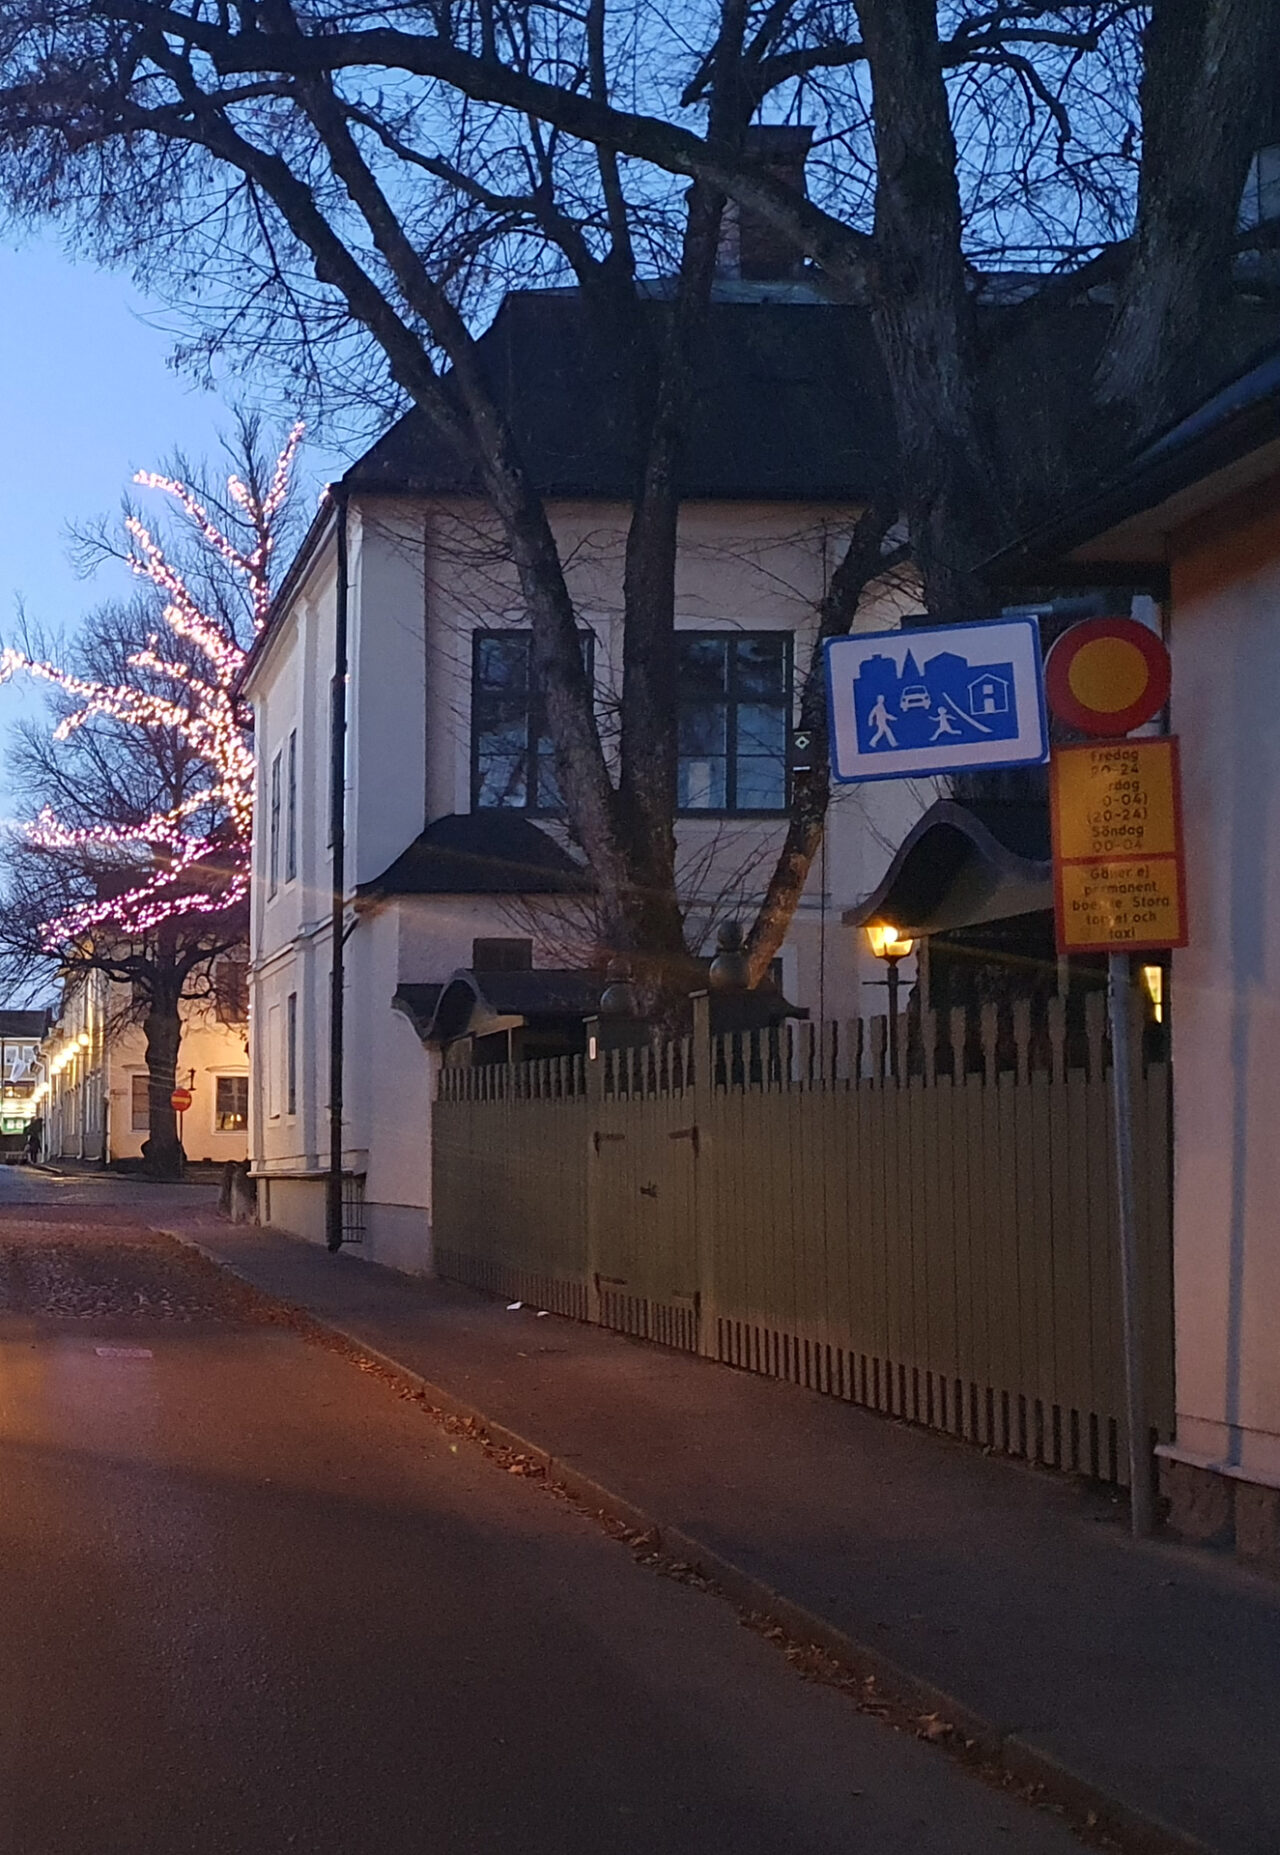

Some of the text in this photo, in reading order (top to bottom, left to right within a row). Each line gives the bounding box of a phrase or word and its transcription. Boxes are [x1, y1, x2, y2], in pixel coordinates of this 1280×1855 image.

[1091, 748, 1139, 762] Fredag
[1091, 825, 1144, 839] Söndag
[1090, 866, 1133, 880] Gäer
[1084, 881, 1159, 897] pmanent
[1072, 896, 1169, 911] boee Stora
[1086, 911, 1157, 925] toret och
[1110, 926, 1135, 940] taxi
